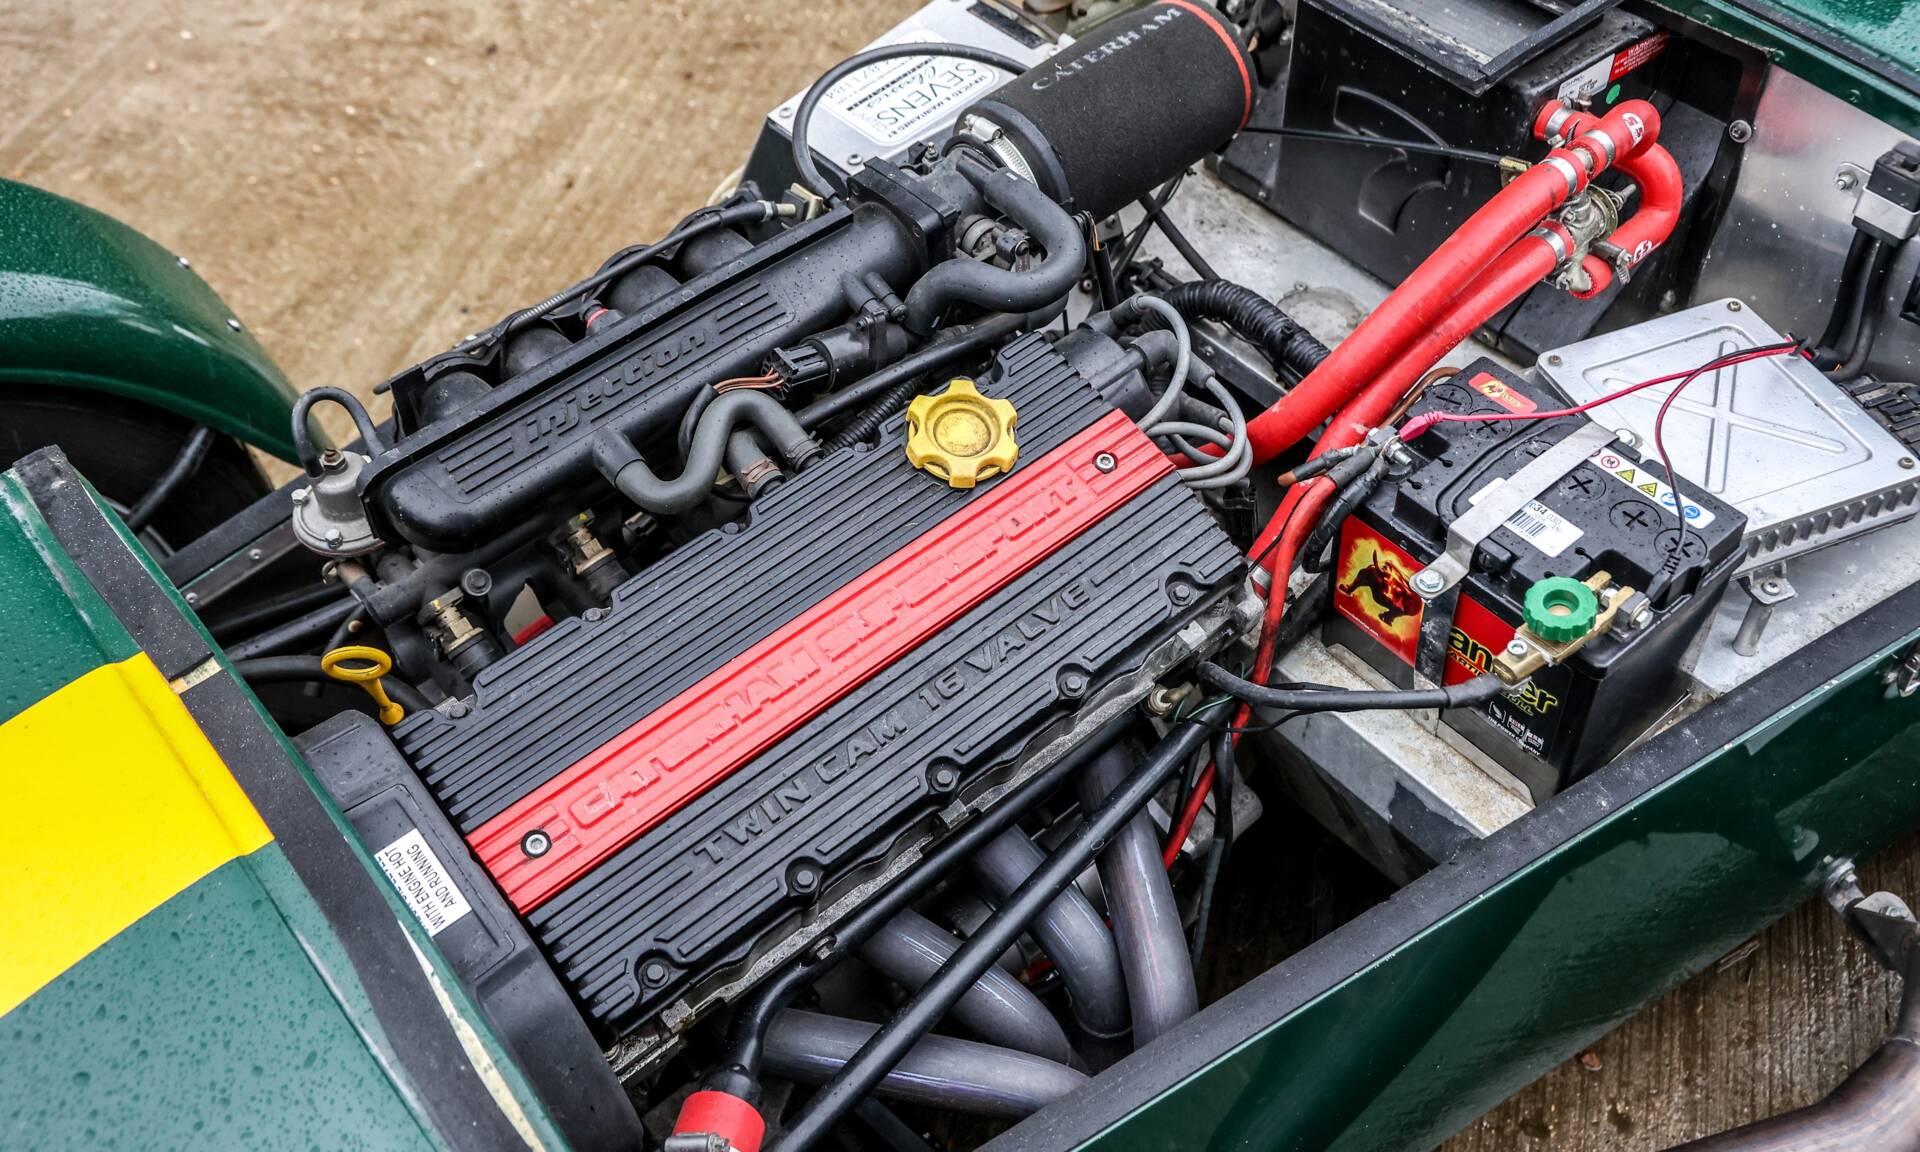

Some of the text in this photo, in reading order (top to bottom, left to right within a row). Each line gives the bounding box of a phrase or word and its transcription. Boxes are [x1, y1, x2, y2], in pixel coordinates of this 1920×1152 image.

[1031, 7, 1183, 91] CATERHAM
[876, 61, 978, 126] SEVENS
[567, 646, 821, 830] CATERHAM
[693, 586, 1090, 865] TWIN CAM 16 VALVE
[1497, 721, 1516, 740] POWER
[384, 847, 406, 870] HOT
[398, 866, 430, 905] ENGINE
[406, 844, 458, 908] AND RUNNING
[421, 900, 446, 930] WITH
